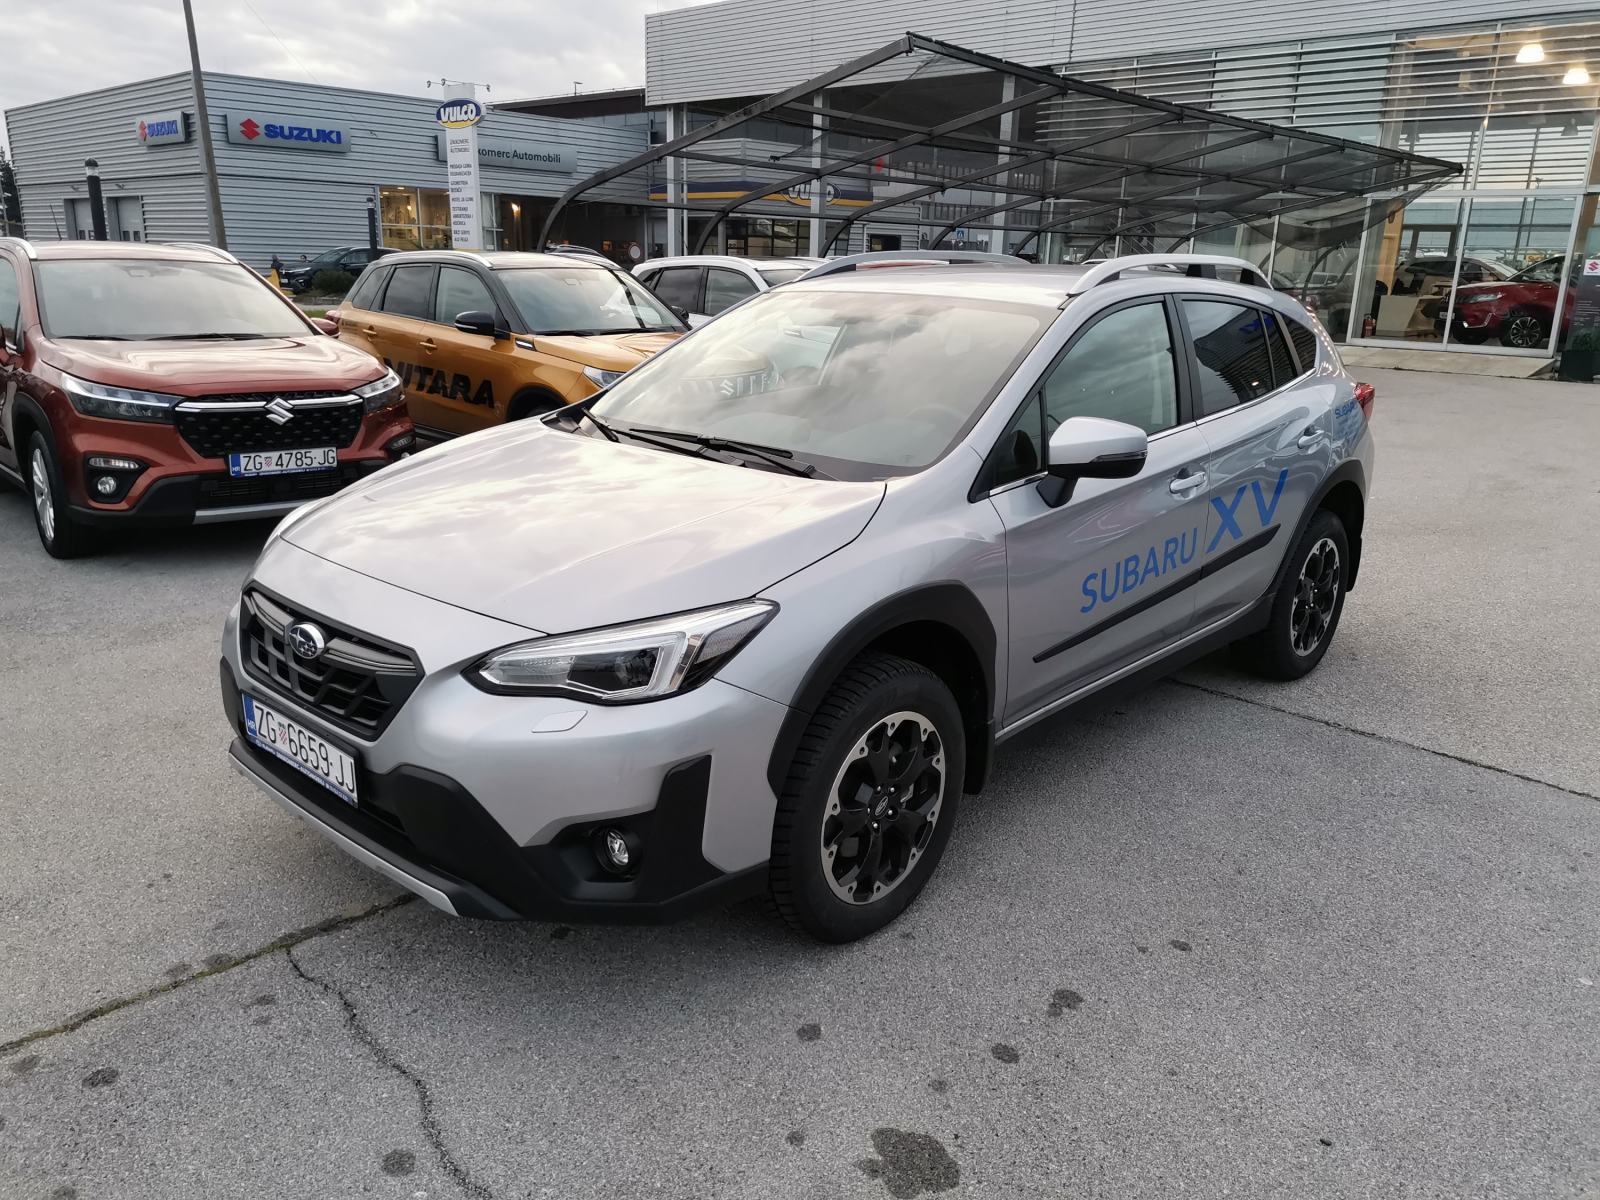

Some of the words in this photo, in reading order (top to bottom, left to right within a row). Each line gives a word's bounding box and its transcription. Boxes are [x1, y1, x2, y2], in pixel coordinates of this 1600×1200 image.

[440, 103, 477, 122] VULCO
[147, 119, 179, 138] SUZUKI
[264, 123, 342, 144] SUZUKI
[512, 149, 561, 163] Automobili
[788, 183, 835, 202] VUO
[242, 454, 263, 472] ZG
[1080, 527, 1198, 614] SUBARU
[1206, 468, 1289, 554] XV
[254, 704, 277, 744] ZG
